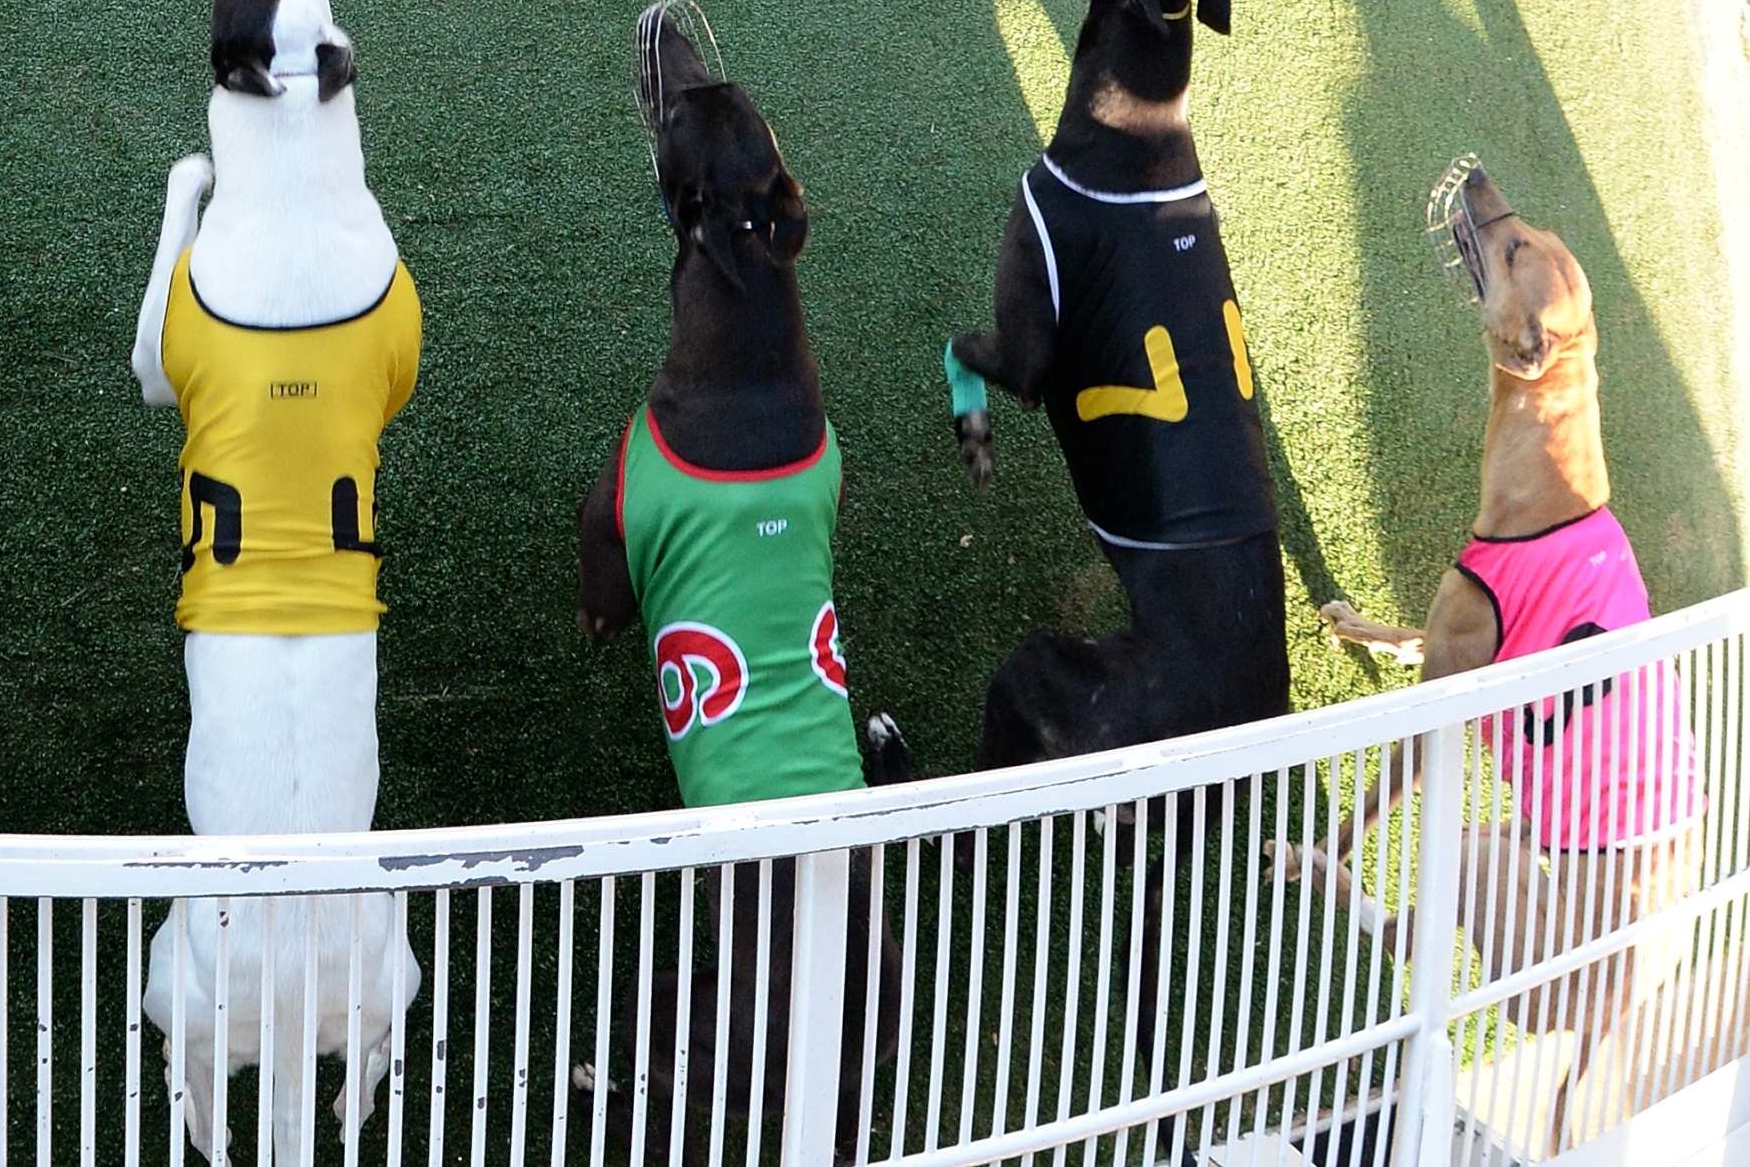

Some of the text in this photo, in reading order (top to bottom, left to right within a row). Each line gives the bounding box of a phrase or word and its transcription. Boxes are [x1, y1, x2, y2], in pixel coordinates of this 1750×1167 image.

[1173, 234, 1197, 252] TOP
[1076, 325, 1188, 422] 7
[277, 382, 310, 397] TOP
[756, 518, 788, 537] TOP
[655, 621, 749, 741] 6
